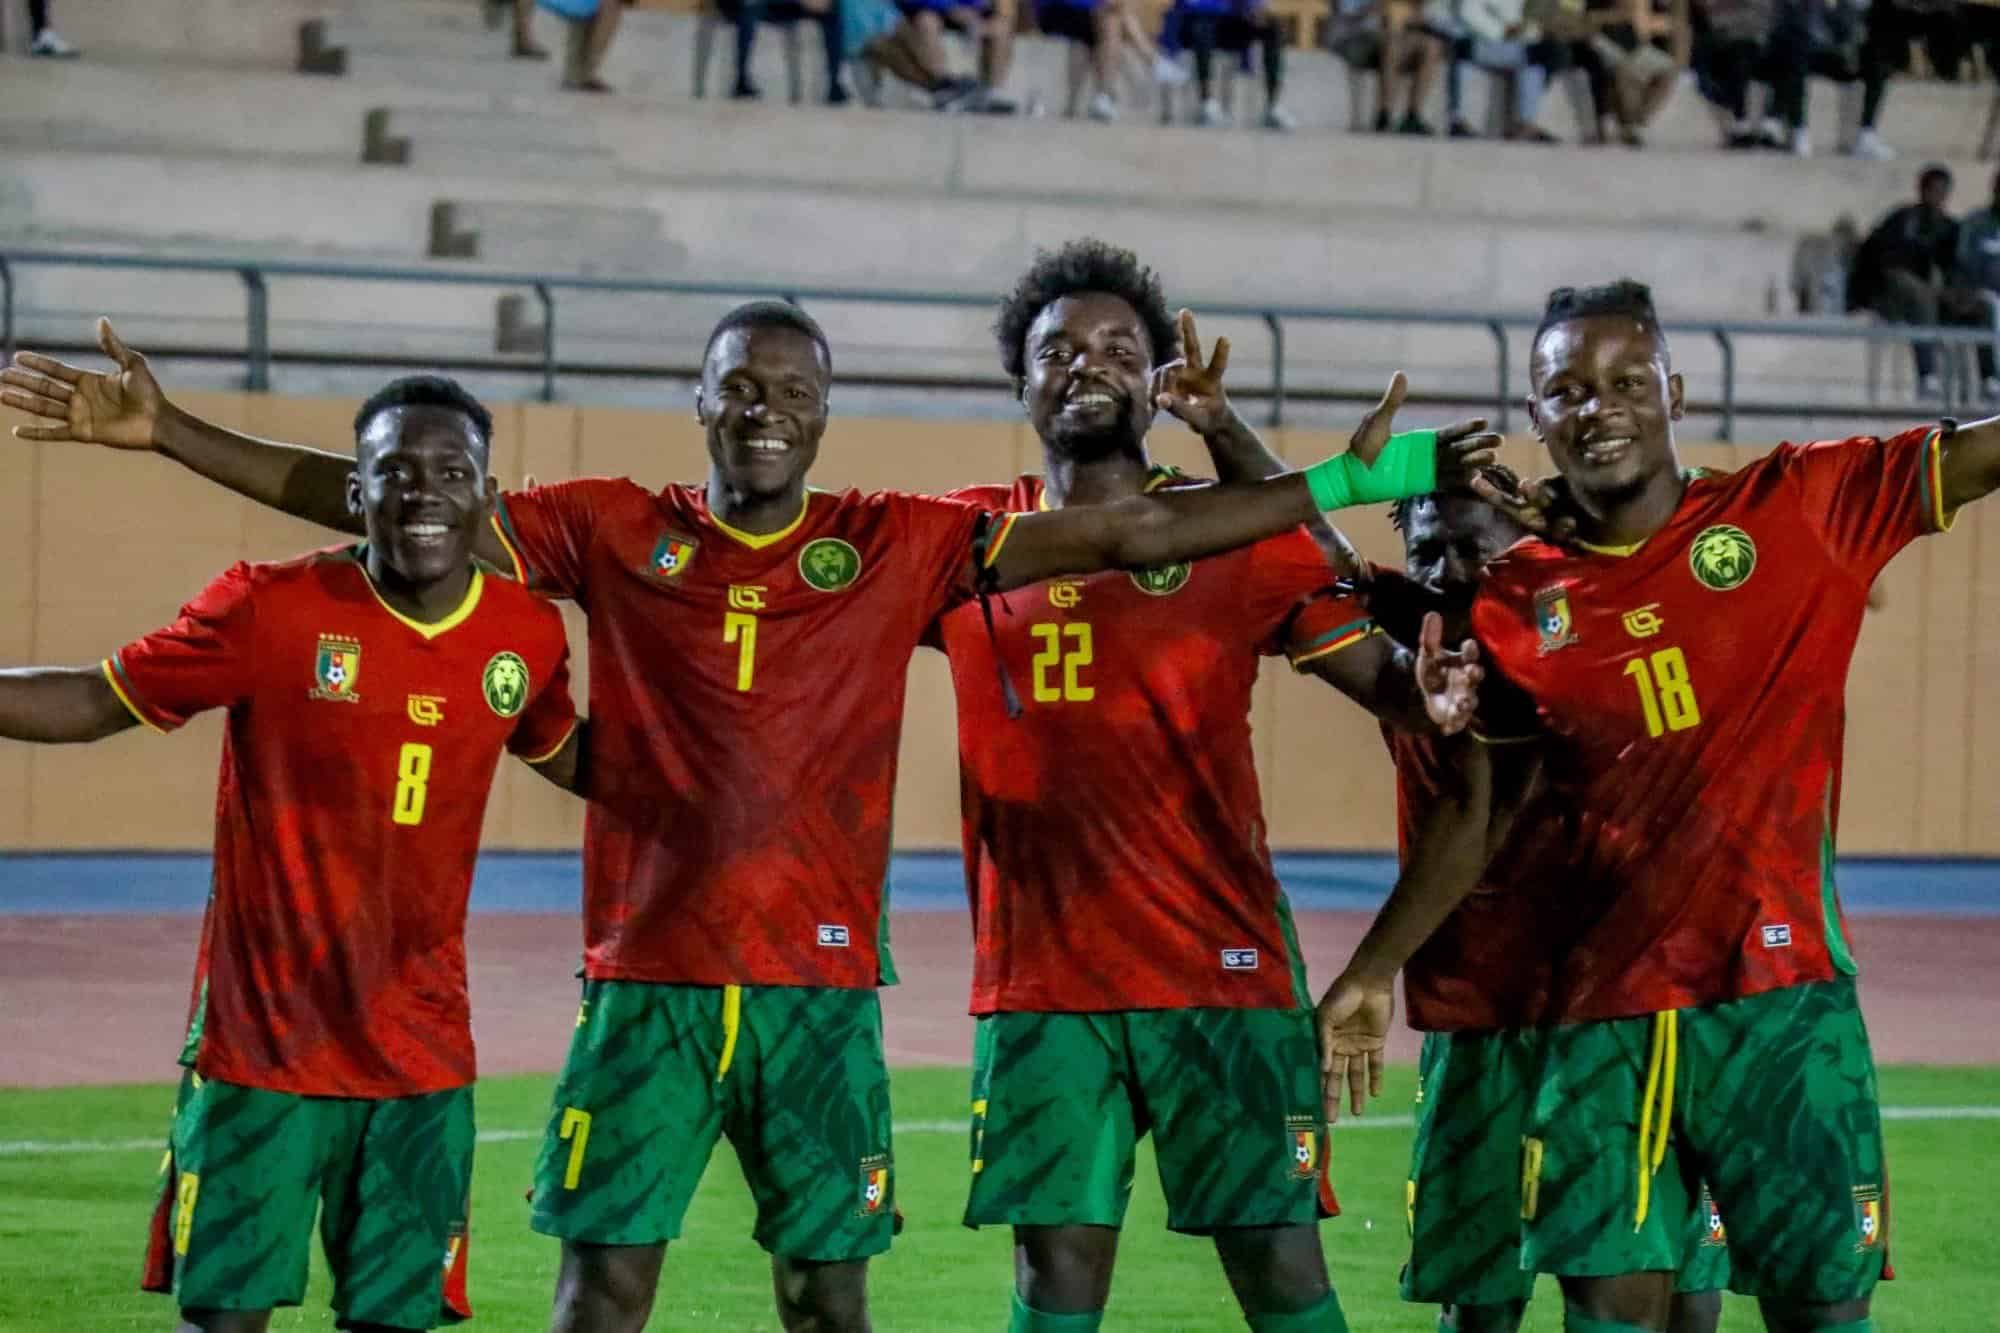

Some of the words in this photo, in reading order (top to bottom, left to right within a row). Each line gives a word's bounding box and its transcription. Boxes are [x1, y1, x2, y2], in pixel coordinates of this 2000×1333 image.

[724, 612, 758, 692] 7
[1031, 623, 1095, 702] 22
[1625, 647, 1701, 738] 18
[392, 742, 433, 825] 8
[560, 1108, 591, 1189] 7
[1520, 1134, 1543, 1221] 8
[174, 1173, 200, 1256] 8
